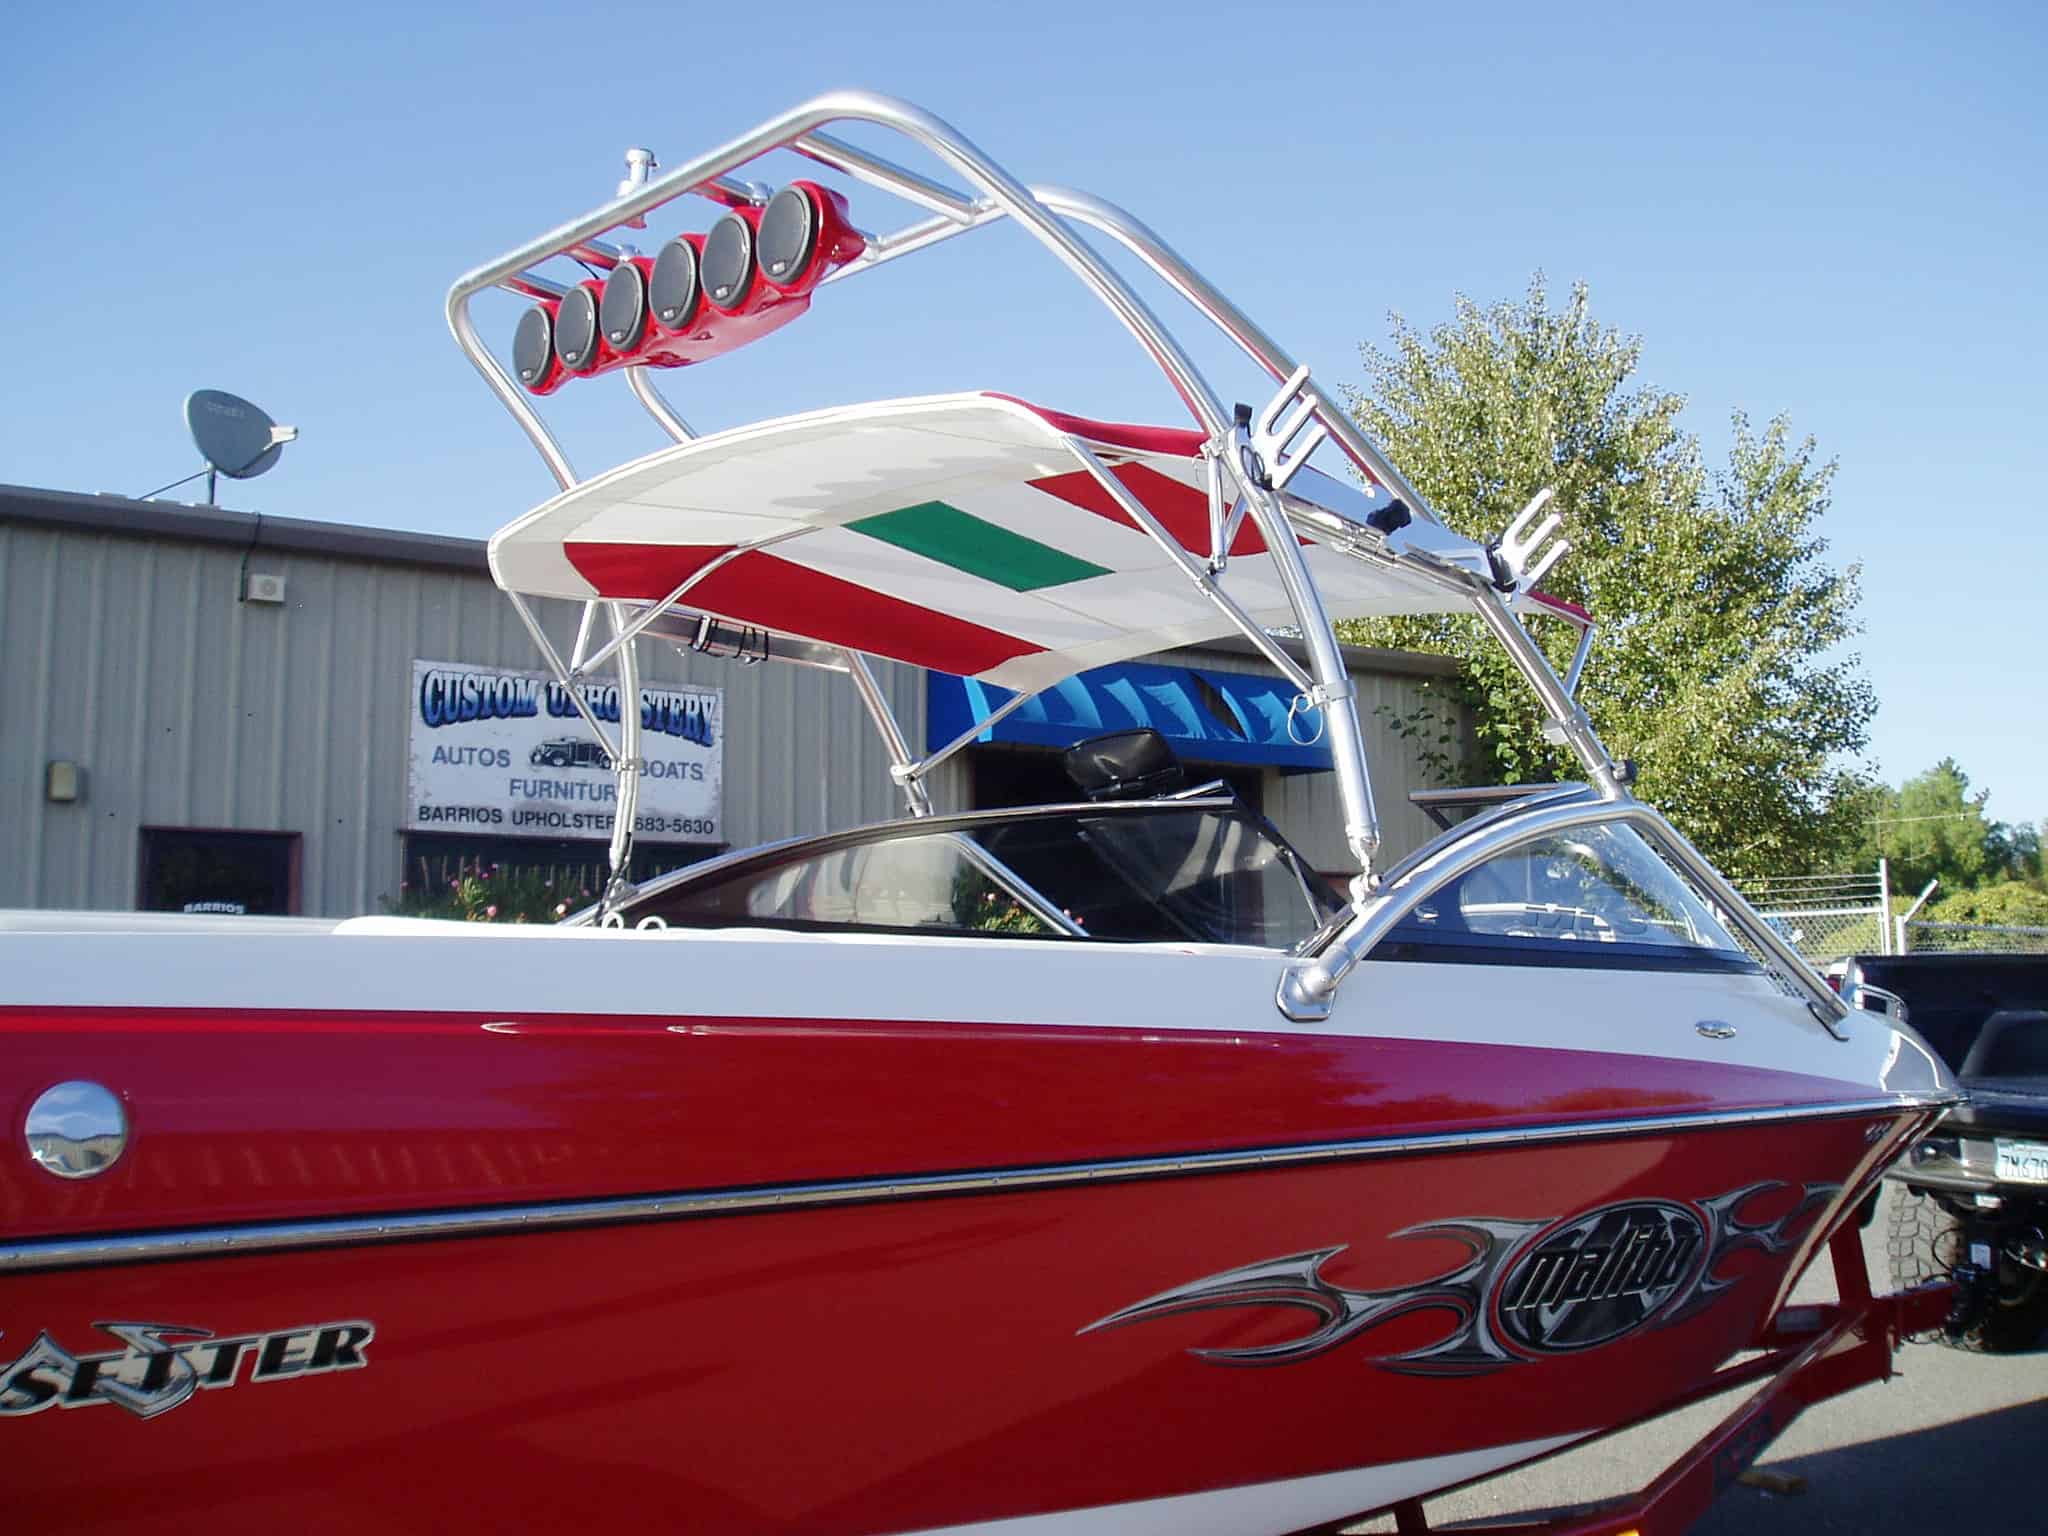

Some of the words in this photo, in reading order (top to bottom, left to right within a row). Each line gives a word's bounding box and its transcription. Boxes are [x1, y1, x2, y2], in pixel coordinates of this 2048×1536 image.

[421, 669, 538, 728] CUSTOM
[545, 680, 717, 747] UPHOSTERY
[432, 746, 511, 768] AUTOS
[639, 760, 704, 781] BOATS
[509, 778, 618, 802] FURNITUR
[418, 805, 503, 824] BARRIOS
[512, 811, 615, 830] UPHOLSTER
[635, 817, 714, 835] 683-5630
